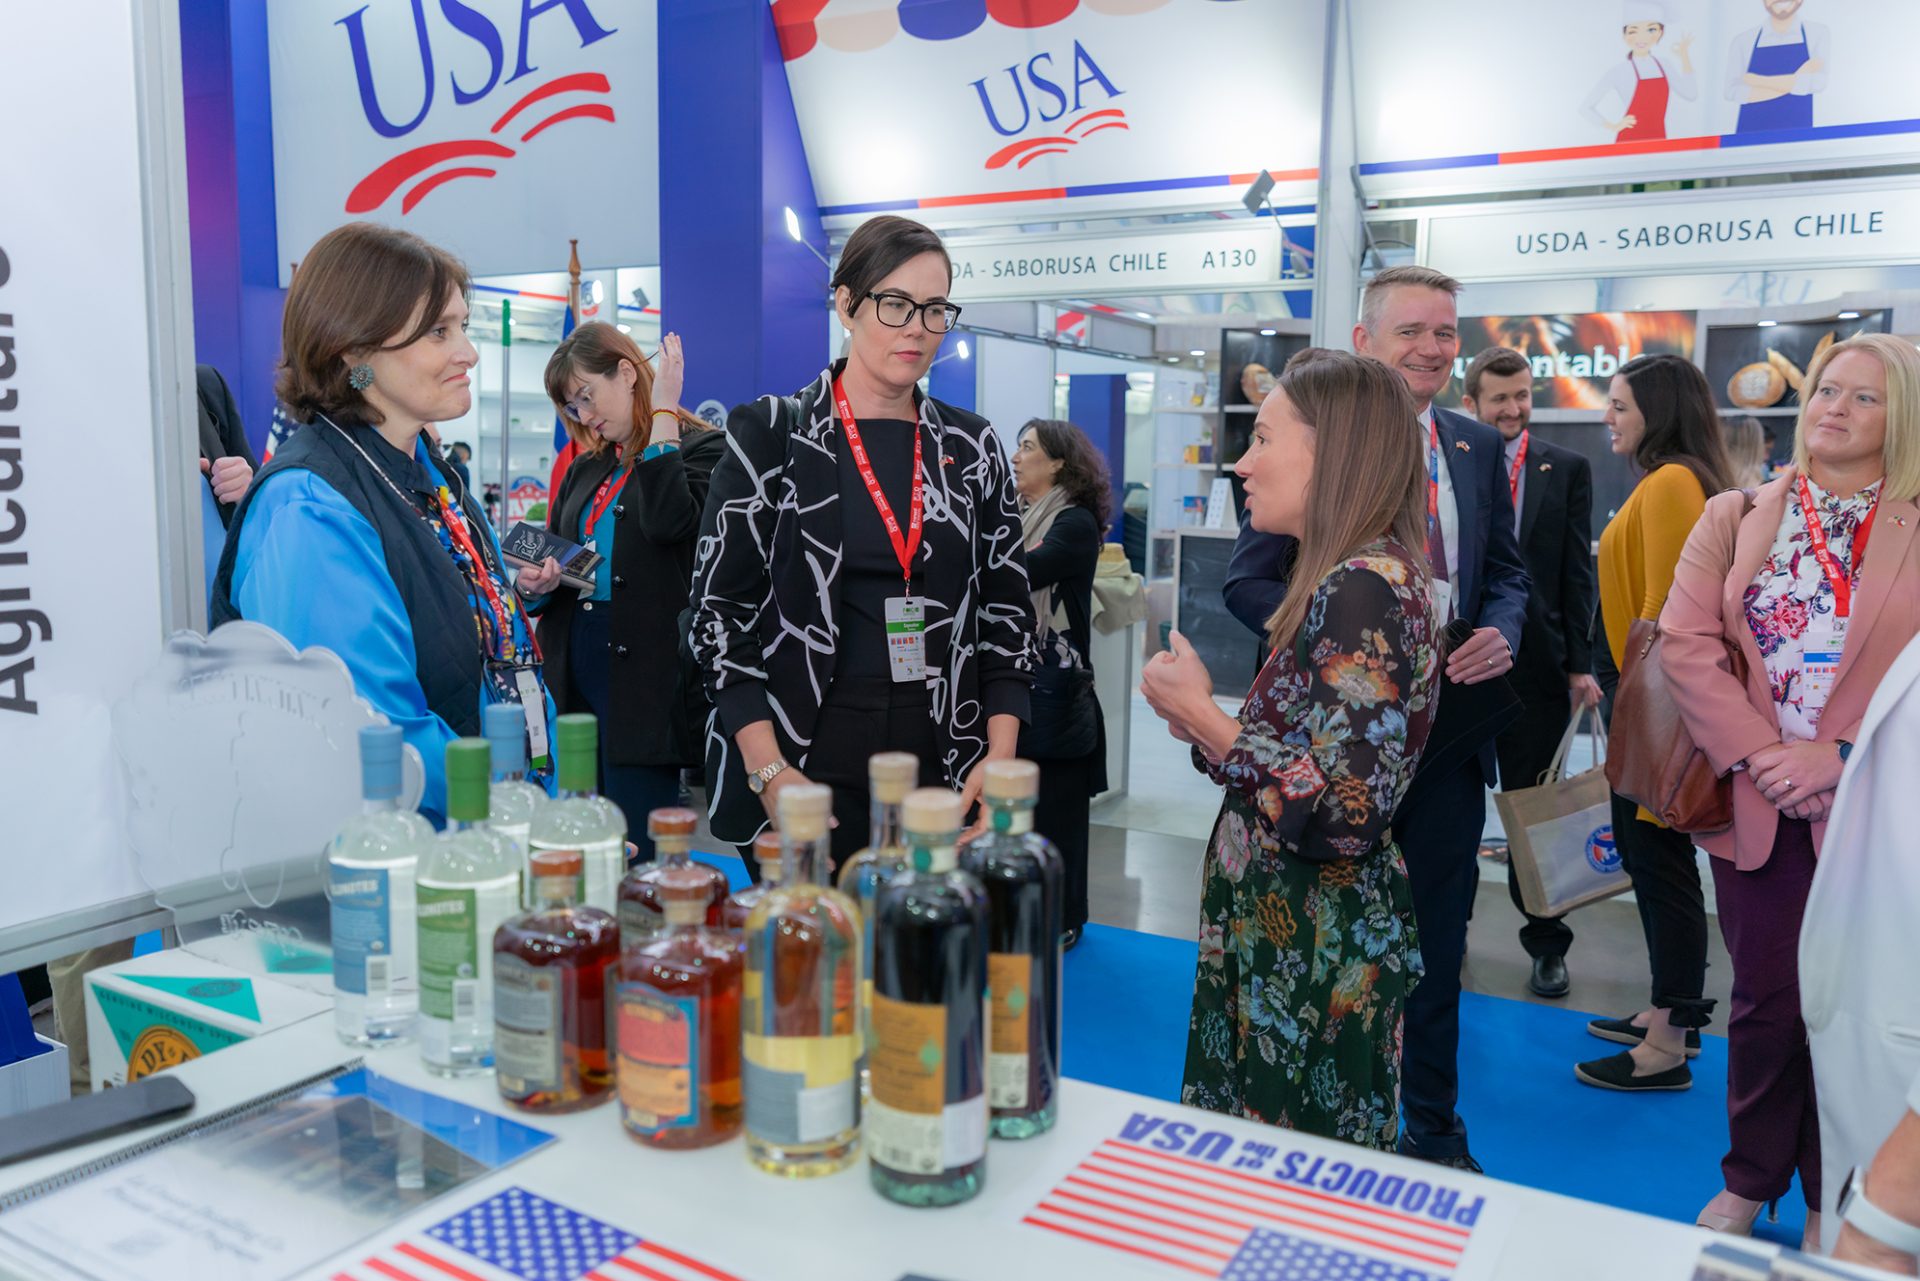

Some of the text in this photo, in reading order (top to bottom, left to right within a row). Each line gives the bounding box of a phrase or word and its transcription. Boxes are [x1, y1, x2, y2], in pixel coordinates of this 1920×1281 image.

[334, 0, 618, 138] USA
[967, 39, 1126, 136] USA
[951, 261, 974, 279] DA
[993, 256, 1096, 278] SABORUSA
[1109, 252, 1167, 272] CHILE
[1202, 248, 1256, 269] A130
[1516, 231, 1588, 254] USDA
[1617, 219, 1773, 250] SABORUSA
[1795, 211, 1884, 237] CHILE
[1118, 1112, 1485, 1227] PRODUCTS of the USA
